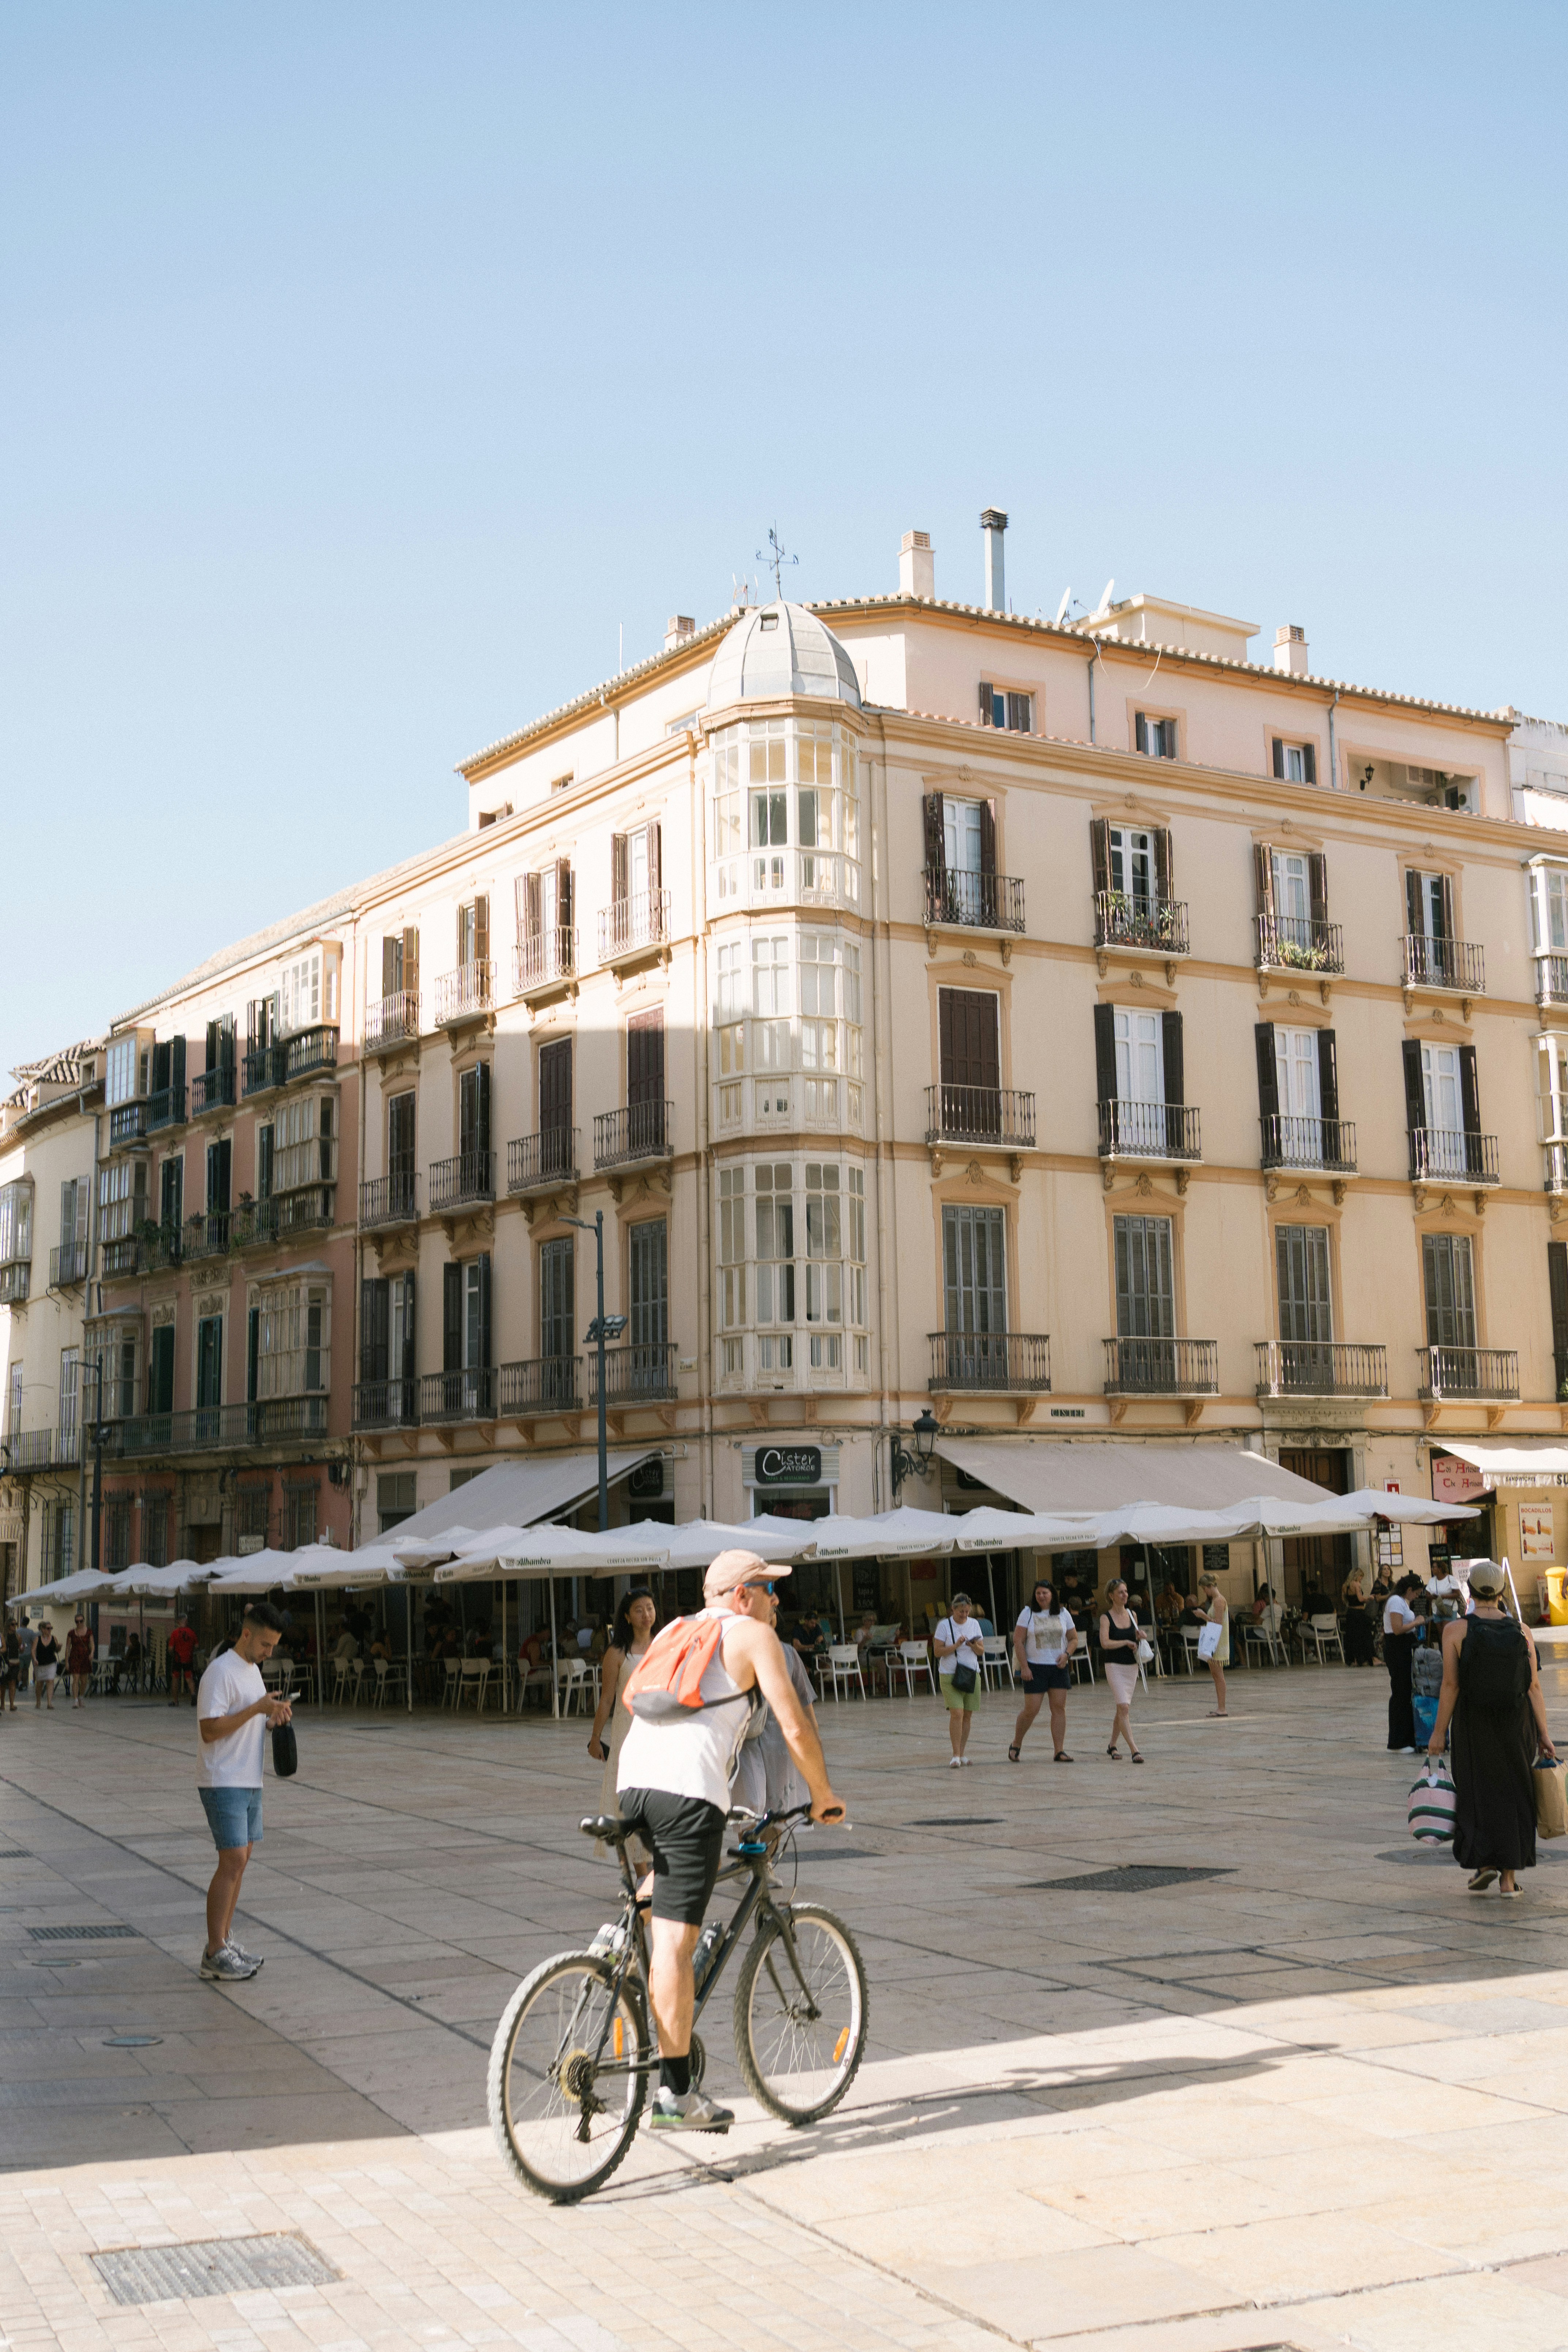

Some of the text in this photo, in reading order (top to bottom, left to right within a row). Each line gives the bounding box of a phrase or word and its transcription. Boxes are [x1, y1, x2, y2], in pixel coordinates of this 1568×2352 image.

[763, 1450, 815, 1476] Cister
[1436, 1462, 1451, 1473] Los
[1277, 1525, 1300, 1533] Alhambra
[974, 1537, 1002, 1547] Alhambra
[819, 1546, 848, 1556] Alhambra
[518, 1556, 551, 1566] Alhambra
